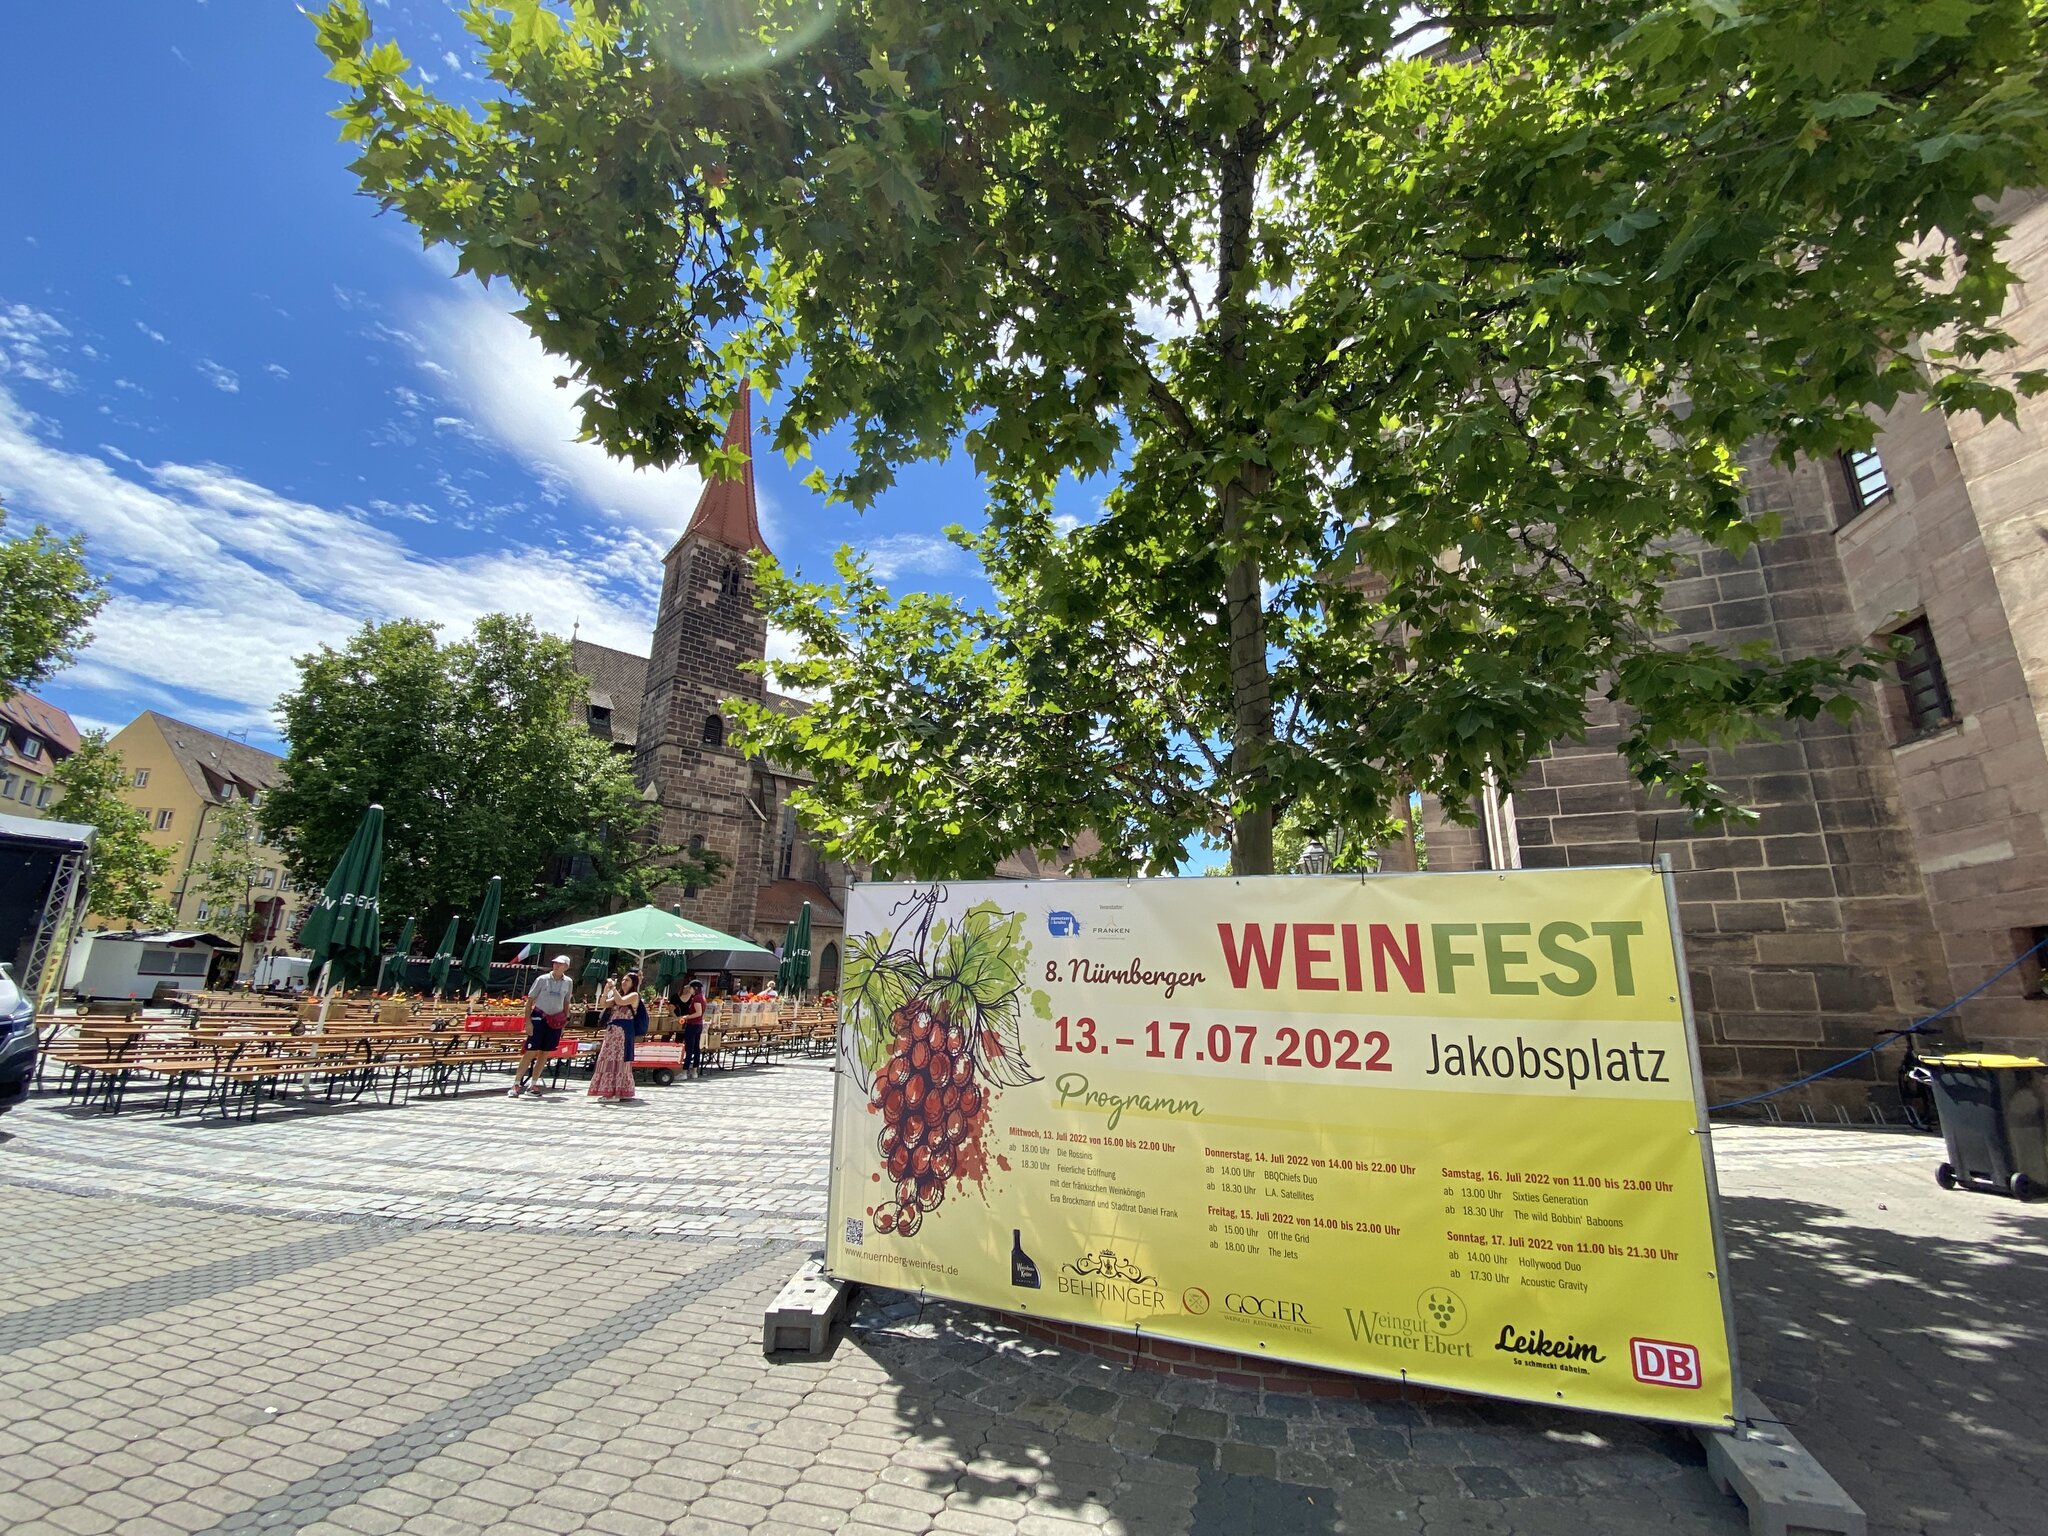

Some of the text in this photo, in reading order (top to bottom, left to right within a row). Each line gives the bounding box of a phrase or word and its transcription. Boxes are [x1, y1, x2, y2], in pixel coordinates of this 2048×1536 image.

[1045, 921, 1643, 999] 8. Nürnberger WEINFEST
[1055, 1016, 1109, 1055] 13.
[1146, 1021, 1393, 1072] 17.07.2022
[1426, 1034, 1670, 1090] Jakobsplatz
[1055, 1073, 1205, 1130] Programm
[1009, 1127, 1041, 1139] Mittwoch,
[1044, 1131, 1054, 1140] 13.
[1056, 1132, 1067, 1141] Juli
[1070, 1133, 1087, 1143] 2022
[1104, 1137, 1123, 1147] 16.00
[1126, 1139, 1136, 1149] bis
[1138, 1140, 1160, 1151] 22.00
[1162, 1143, 1175, 1152] Uhr
[1009, 1143, 1093, 1160] ab 18.00 Uhr Die Rossinis
[1022, 1160, 1116, 1180] 18.30 Uhr Feierliche Eröffnung
[1205, 1148, 1416, 1175] Donnerstag, 14. Juli 2022 von 14.00 bis 22.00 Uhr
[1206, 1165, 1318, 1185] ab 14.00 Uhr BBQChiefs Duo
[1442, 1168, 1673, 1192] Samstag, 16. Juli 2022 von 11.00 bis 23.00 Uhr
[1050, 1179, 1145, 1198] mit der fränkischen Weinkönigin
[1207, 1182, 1314, 1201] ab 18.30 Uhr L.A. Satellites
[1444, 1187, 1588, 1206] ab 13.00 Uhr Sixties Generation
[1050, 1194, 1178, 1218] Eva Brockmann und Stadtrat Daniel Frank
[1445, 1205, 1455, 1214] ab
[1463, 1206, 1487, 1217] 18.30
[1489, 1208, 1504, 1218] Uhr
[1515, 1210, 1529, 1220] The
[1532, 1212, 1548, 1222] wild
[1587, 1216, 1623, 1227] Baboons
[1208, 1206, 1400, 1235] Freitag, 15. Juli 2022 von 14.00 bis 23.00 Uhr
[1209, 1223, 1309, 1243] ab 15.00 Uhr Off the Grid
[1210, 1240, 1298, 1259] ab 18.00 Uhr The Jets
[1447, 1231, 1678, 1260] Sonntag, 17. Juli 2022 von 11.00 bis 21.30 Uhr
[845, 1246, 958, 1276] www.nuernberg-weinfest.de
[1449, 1251, 1581, 1271] ab 14.00 Uhr Hollywood Duo
[1058, 1276, 1165, 1310] BEHRINGER
[1450, 1269, 1588, 1293] ab 17.30 Uhr Acoustic Gravity
[1225, 1293, 1311, 1324] GOGER
[1344, 1307, 1430, 1344] Weingut
[1424, 1334, 1473, 1357] Ebert
[1495, 1325, 1606, 1363] Leikeim
[1525, 1360, 1557, 1370] schmeckt
[1560, 1363, 1590, 1375] daheim.
[1640, 1345, 1693, 1381] DB
